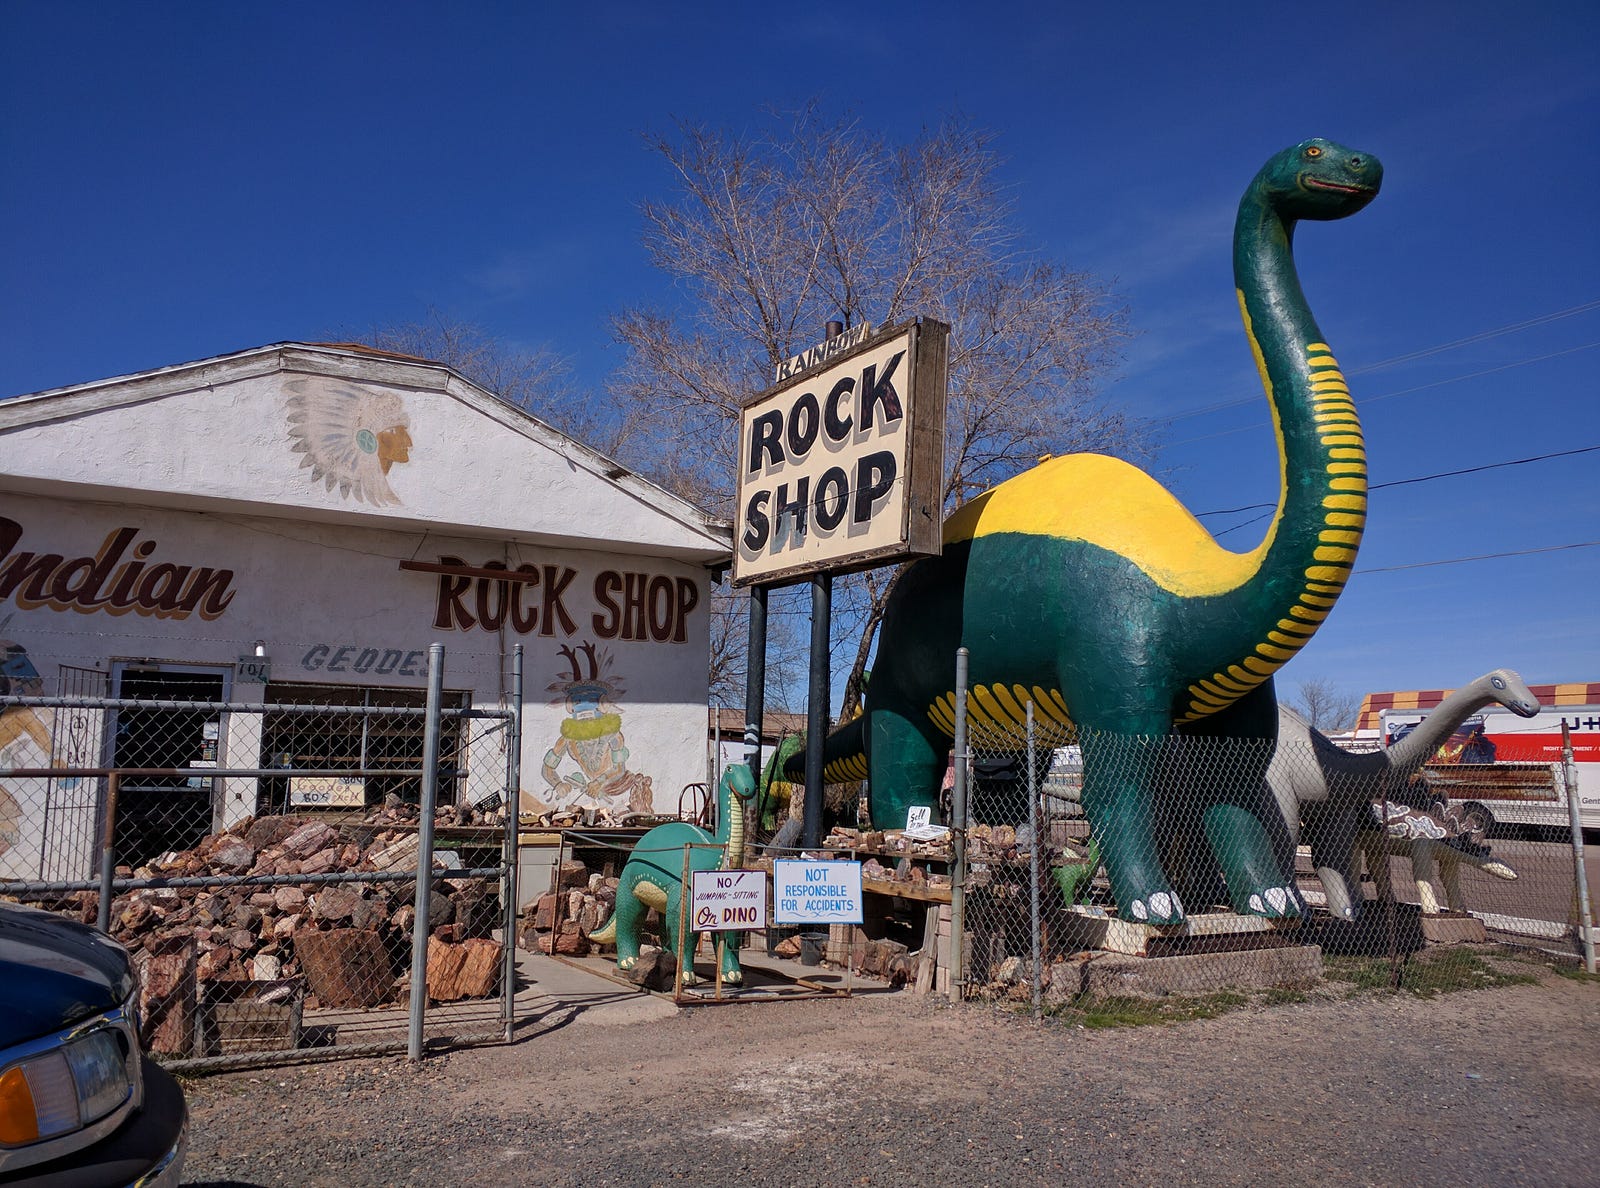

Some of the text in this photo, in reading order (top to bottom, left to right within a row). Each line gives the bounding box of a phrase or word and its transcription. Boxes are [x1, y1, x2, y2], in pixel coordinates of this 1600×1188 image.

[776, 320, 866, 383] RAINBOW
[747, 350, 907, 480] ROCK
[741, 450, 897, 558] SHOP
[432, 555, 699, 643] ROCK SHOP
[301, 644, 430, 677] GEODE
[910, 808, 926, 822] Sell
[806, 868, 829, 882] NOT
[785, 884, 847, 896] RESPONSIBLE
[696, 906, 757, 926] On DINO
[781, 899, 858, 911] FOR ACCIDENTS.
